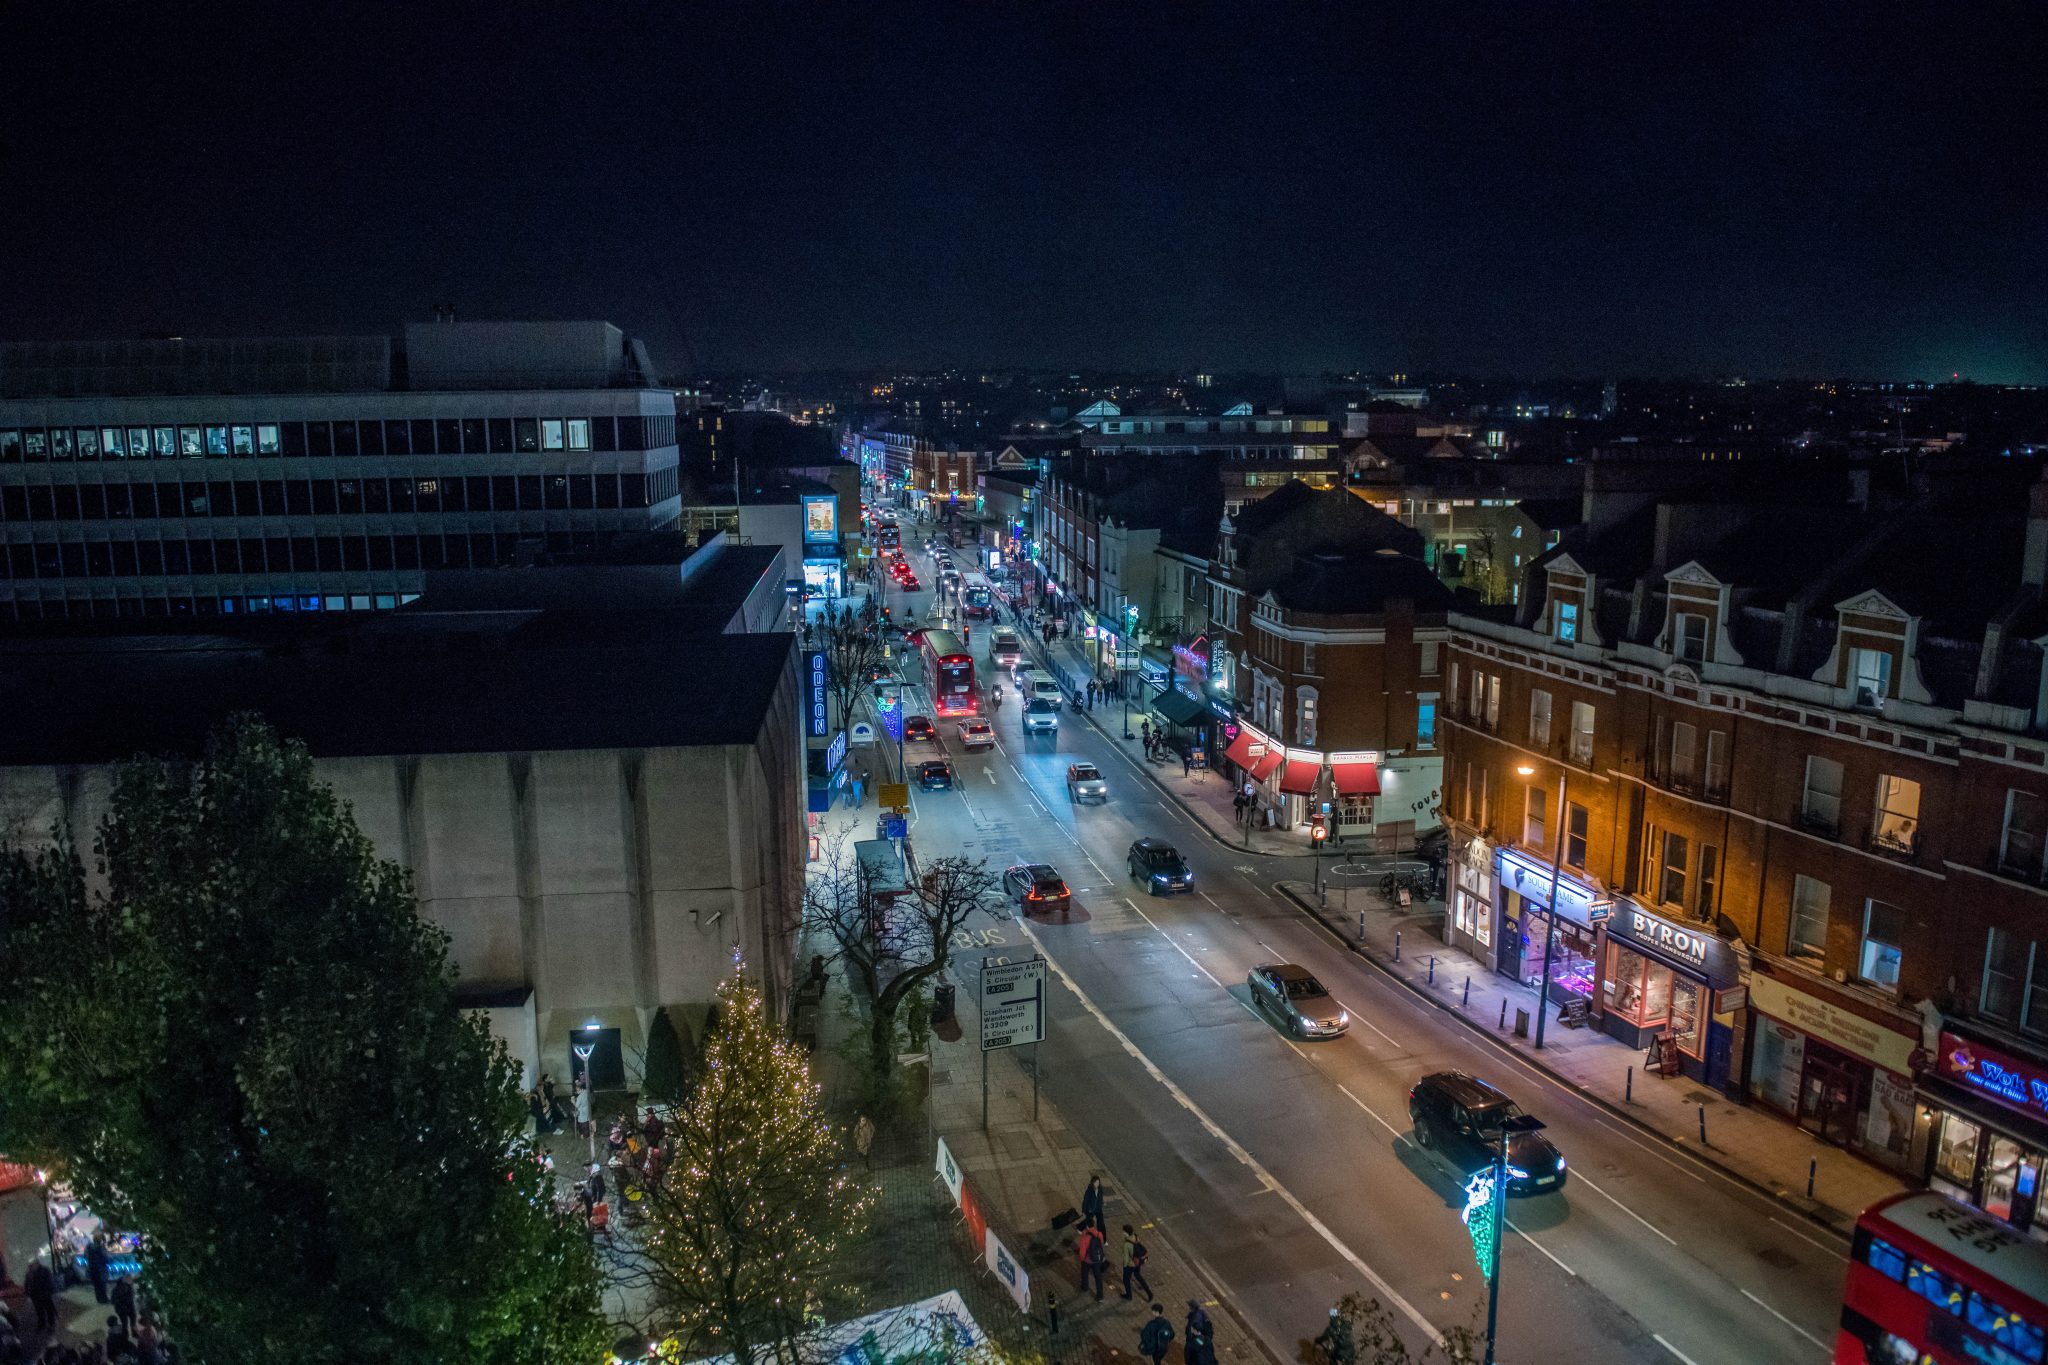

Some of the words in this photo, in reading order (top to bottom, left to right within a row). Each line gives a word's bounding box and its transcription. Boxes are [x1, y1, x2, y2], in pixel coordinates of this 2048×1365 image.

[813, 655, 825, 735] ODEON
[953, 928, 1007, 949] BUS
[1633, 912, 1707, 960] BYRON
[1660, 942, 1703, 966] HAMBURGERS
[986, 966, 1023, 976] Wimbledon
[994, 975, 1021, 983] Circular
[1023, 971, 1039, 979] (W)
[984, 1007, 1012, 1017] Clapham
[984, 1012, 1025, 1023] Wandsworth
[992, 1028, 1018, 1036] Circular
[1980, 1060, 2025, 1092] Wok
